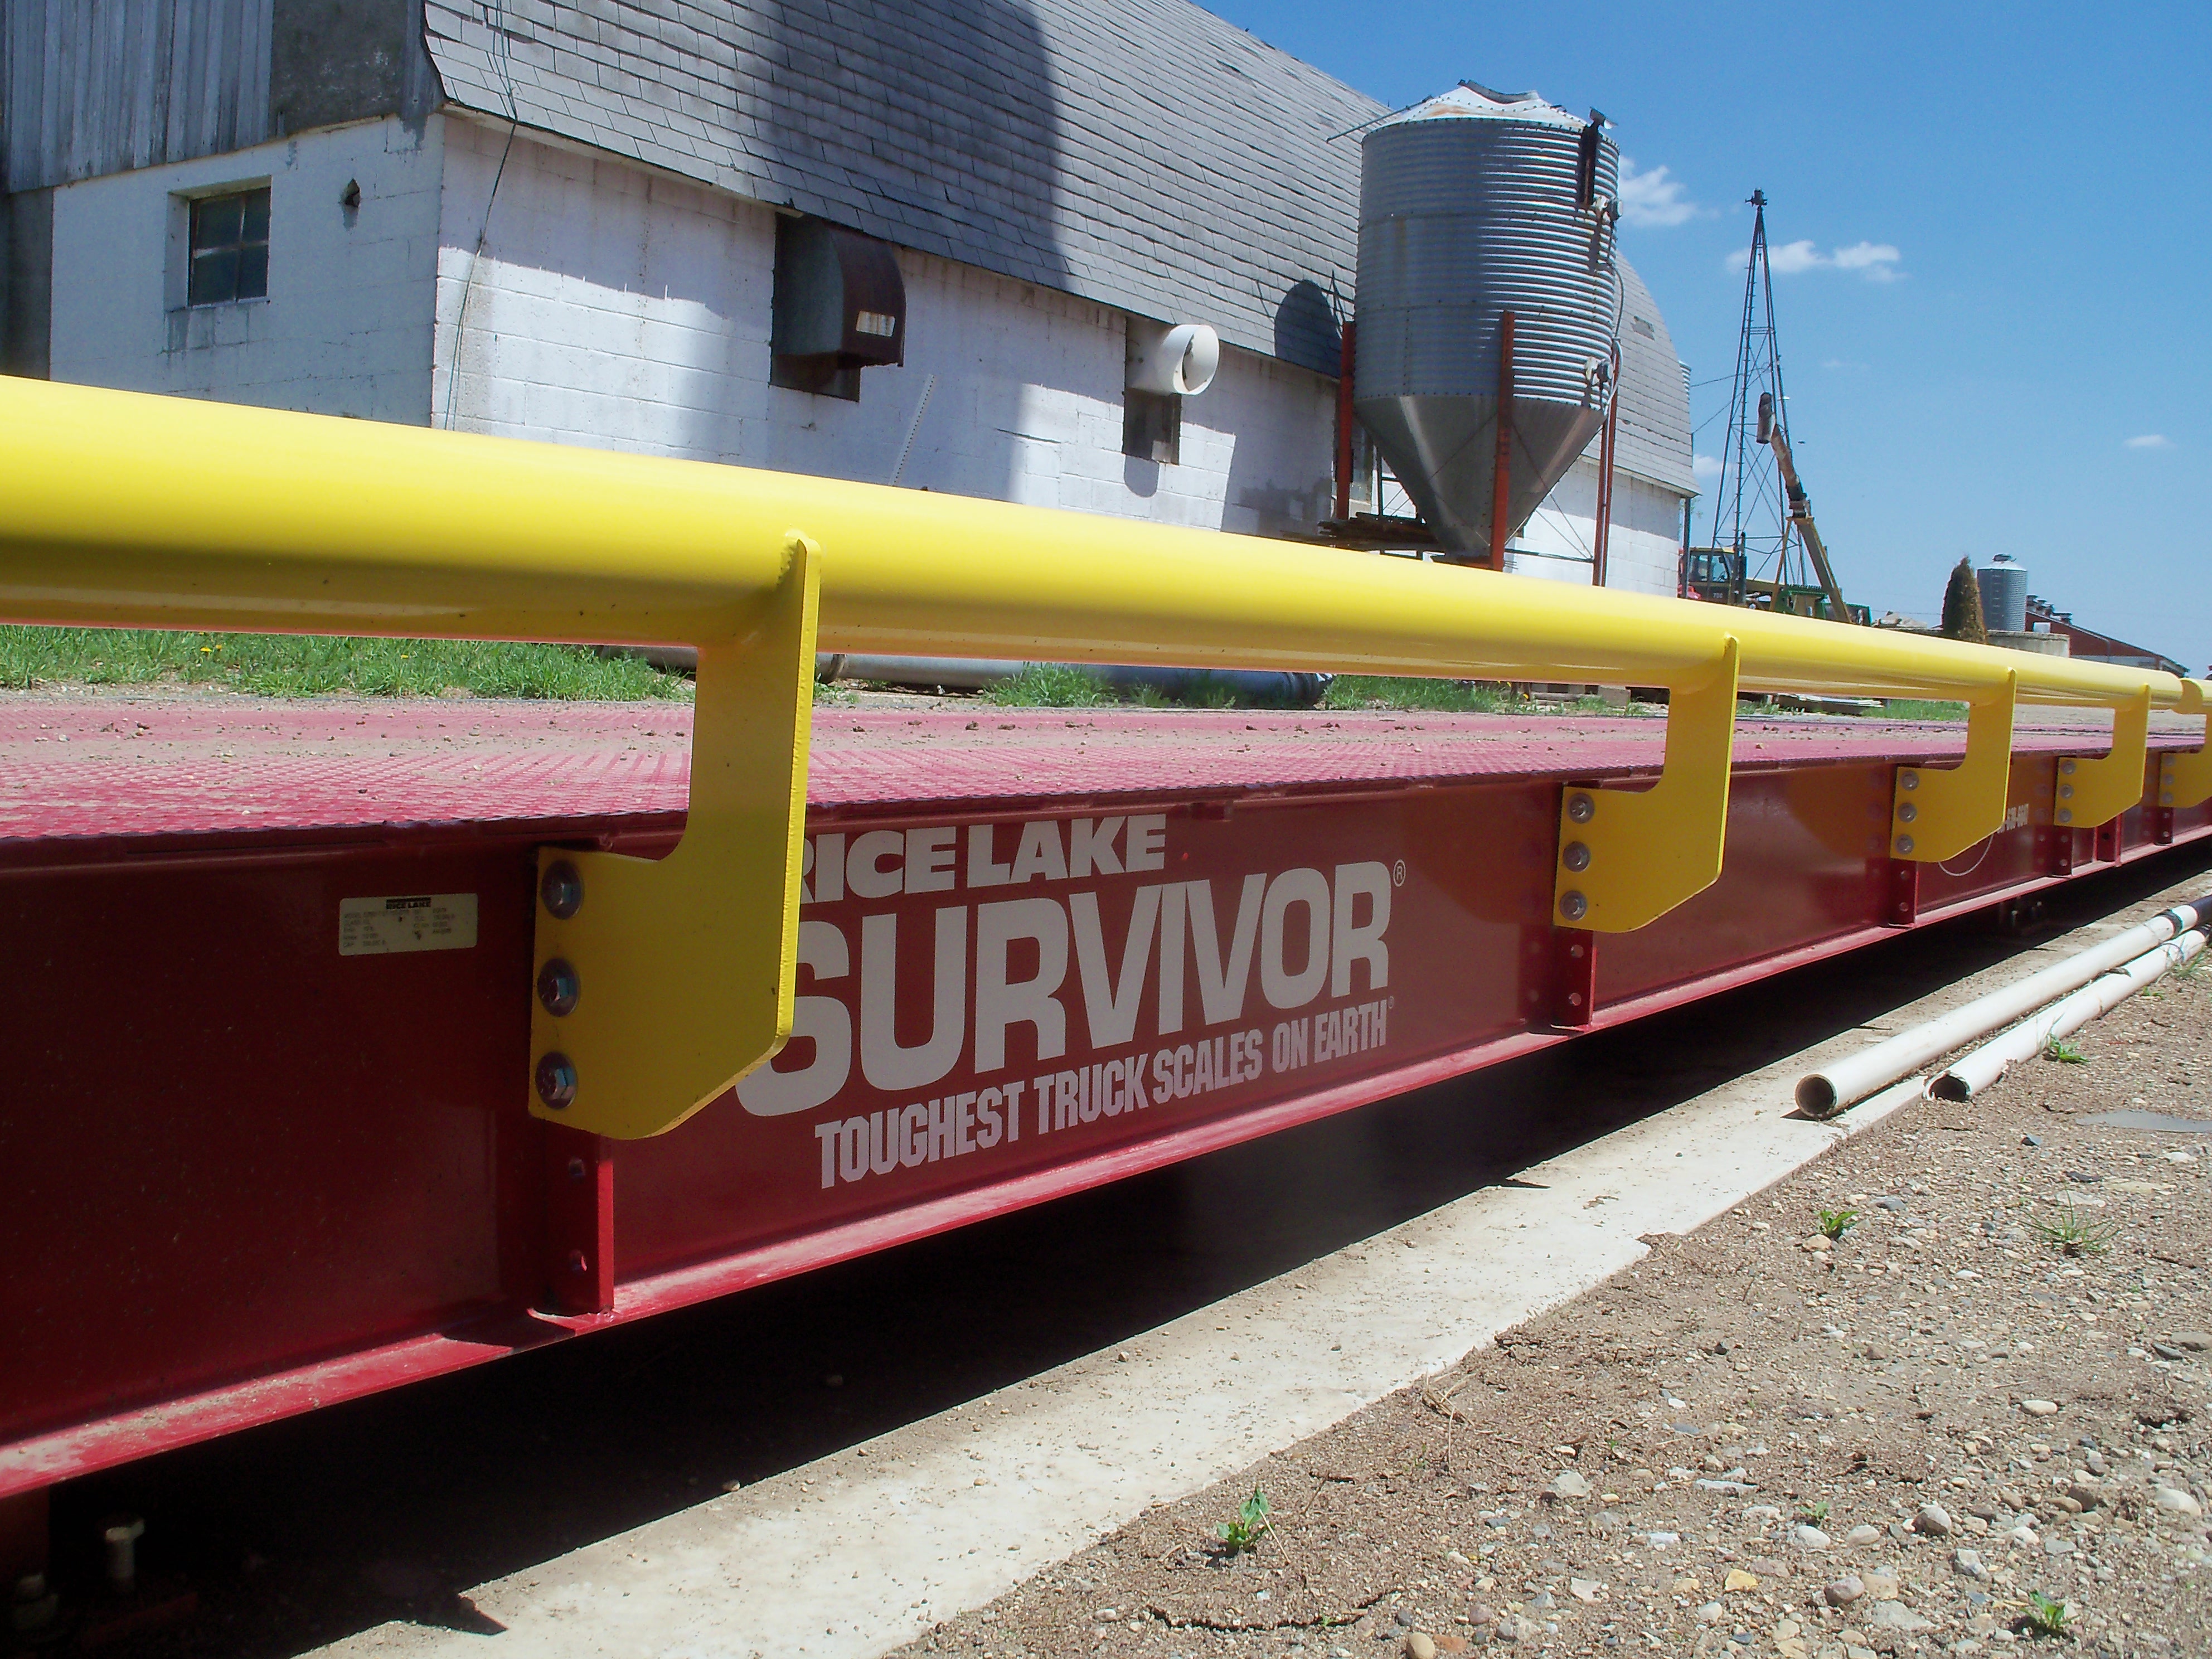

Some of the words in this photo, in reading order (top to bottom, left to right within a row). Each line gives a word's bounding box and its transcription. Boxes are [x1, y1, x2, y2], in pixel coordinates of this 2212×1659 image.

[800, 826, 957, 904] ICE
[967, 813, 1166, 888] LAKE
[814, 1080, 1025, 1190] TOUGHEST
[1034, 1052, 1148, 1136] TRUCK
[1152, 1028, 1263, 1105] SCALES
[1272, 1017, 1308, 1074] ON
